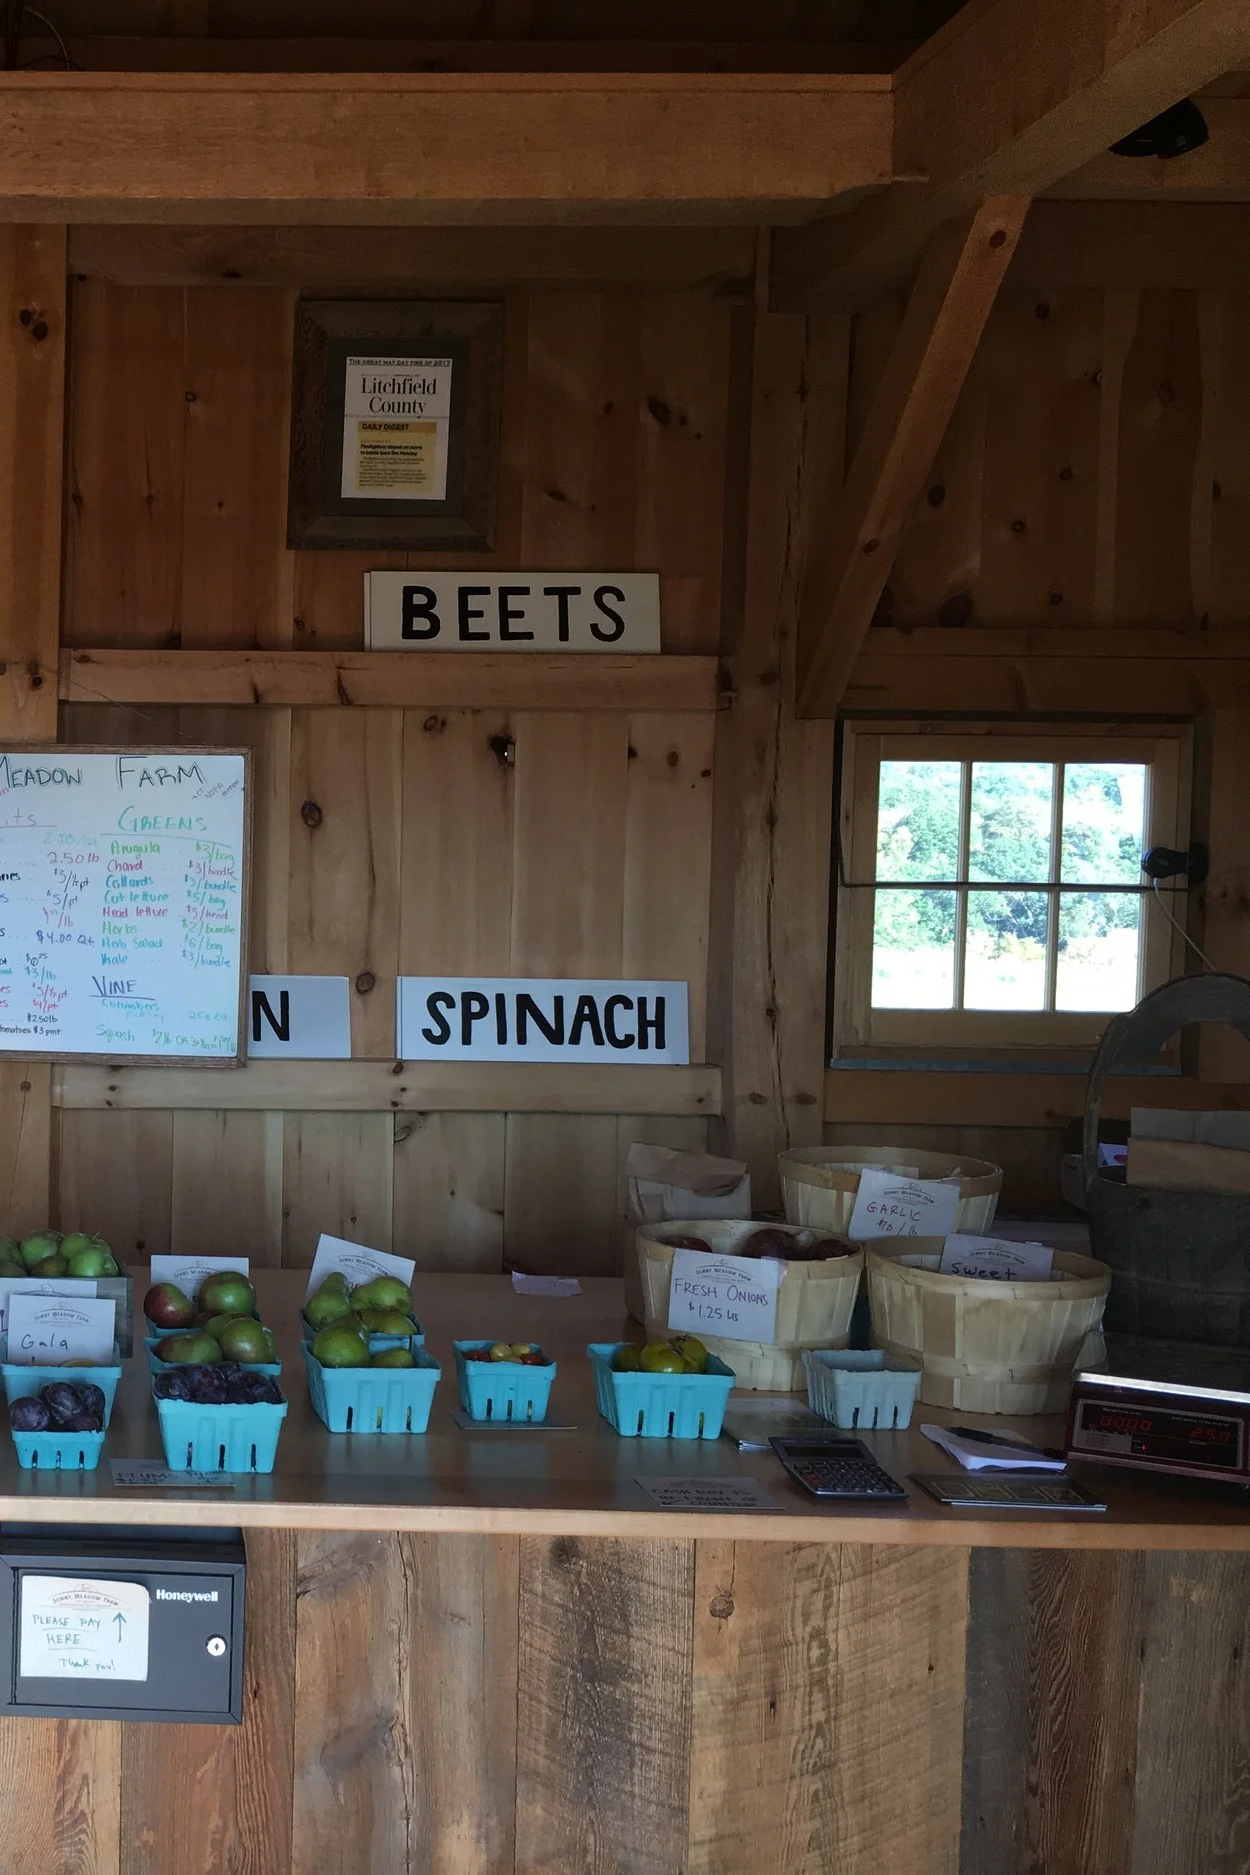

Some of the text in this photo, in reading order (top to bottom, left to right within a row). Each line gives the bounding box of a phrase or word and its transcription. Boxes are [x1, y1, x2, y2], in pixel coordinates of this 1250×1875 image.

[361, 377, 437, 395] Litchfield
[369, 397, 426, 418] County
[362, 423, 410, 431] DAILY DIGEST
[401, 585, 626, 643] BEETS
[116, 756, 207, 791] FARM
[118, 805, 208, 833] GREENS
[110, 840, 161, 860] Arugula
[92, 975, 138, 996] VINE
[421, 990, 666, 1050] SPINACH
[95, 1024, 135, 1043] Squash
[867, 1201, 921, 1222] GARLIC
[674, 1278, 768, 1306] FRESH ONIONS
[21, 1333, 69, 1351] Gala
[156, 1589, 218, 1603] Honeywell
[32, 1614, 101, 1629] PLEASE PAY
[46, 1633, 81, 1645] HERE
[59, 1657, 90, 1669] Thank
